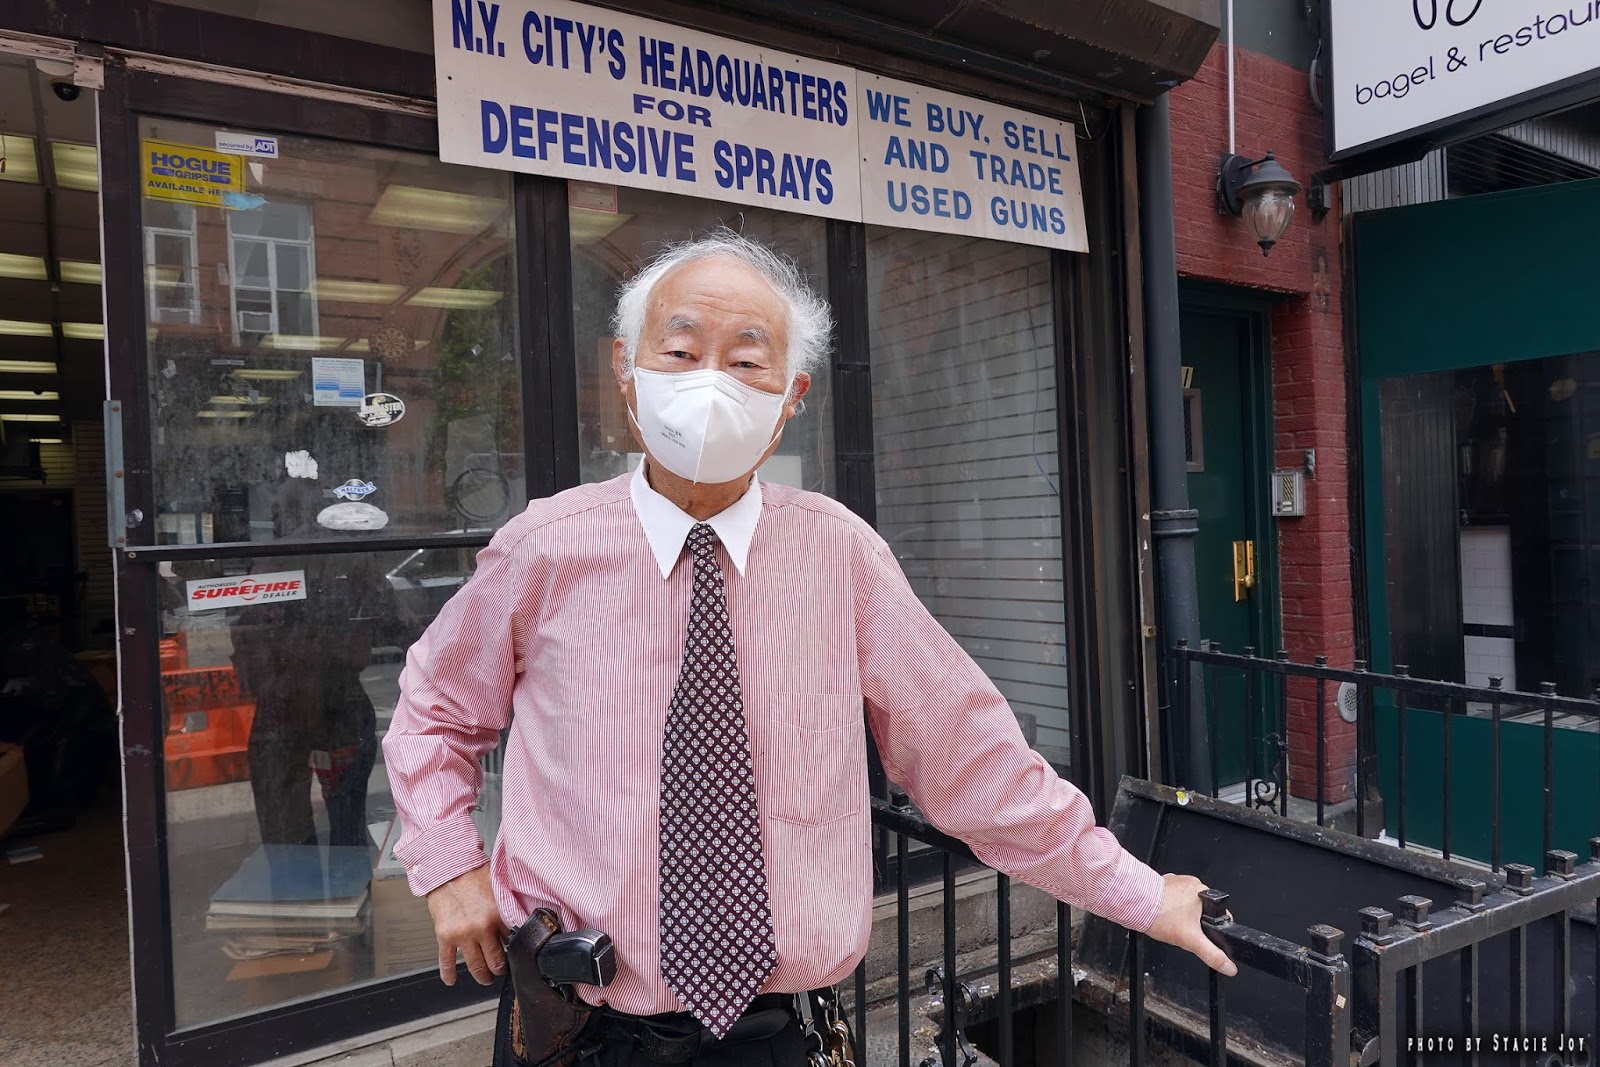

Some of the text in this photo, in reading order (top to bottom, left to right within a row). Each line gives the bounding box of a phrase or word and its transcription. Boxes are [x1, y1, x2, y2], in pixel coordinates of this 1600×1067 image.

[452, 0, 849, 127] N.Y. CITY'S HEADQUARTERS
[1355, 55, 1436, 105] bagel
[1446, 46, 1468, 73] &
[633, 93, 712, 128] FOR
[866, 89, 1071, 162] WE BUY, SELL
[218, 141, 245, 150] secured
[255, 140, 275, 154] ADT
[480, 100, 834, 206] DEFENSIVE SPRAYS
[151, 152, 231, 175] HOGUE
[175, 170, 210, 182] GRIPS
[884, 135, 1064, 196] AND TRADE
[148, 181, 204, 193] AVAILABLE
[887, 180, 1066, 235] USED GUNS
[192, 580, 301, 599] SUREFIRE
[197, 581, 238, 590] AUTHORIZED
[262, 590, 298, 599] DEALER
